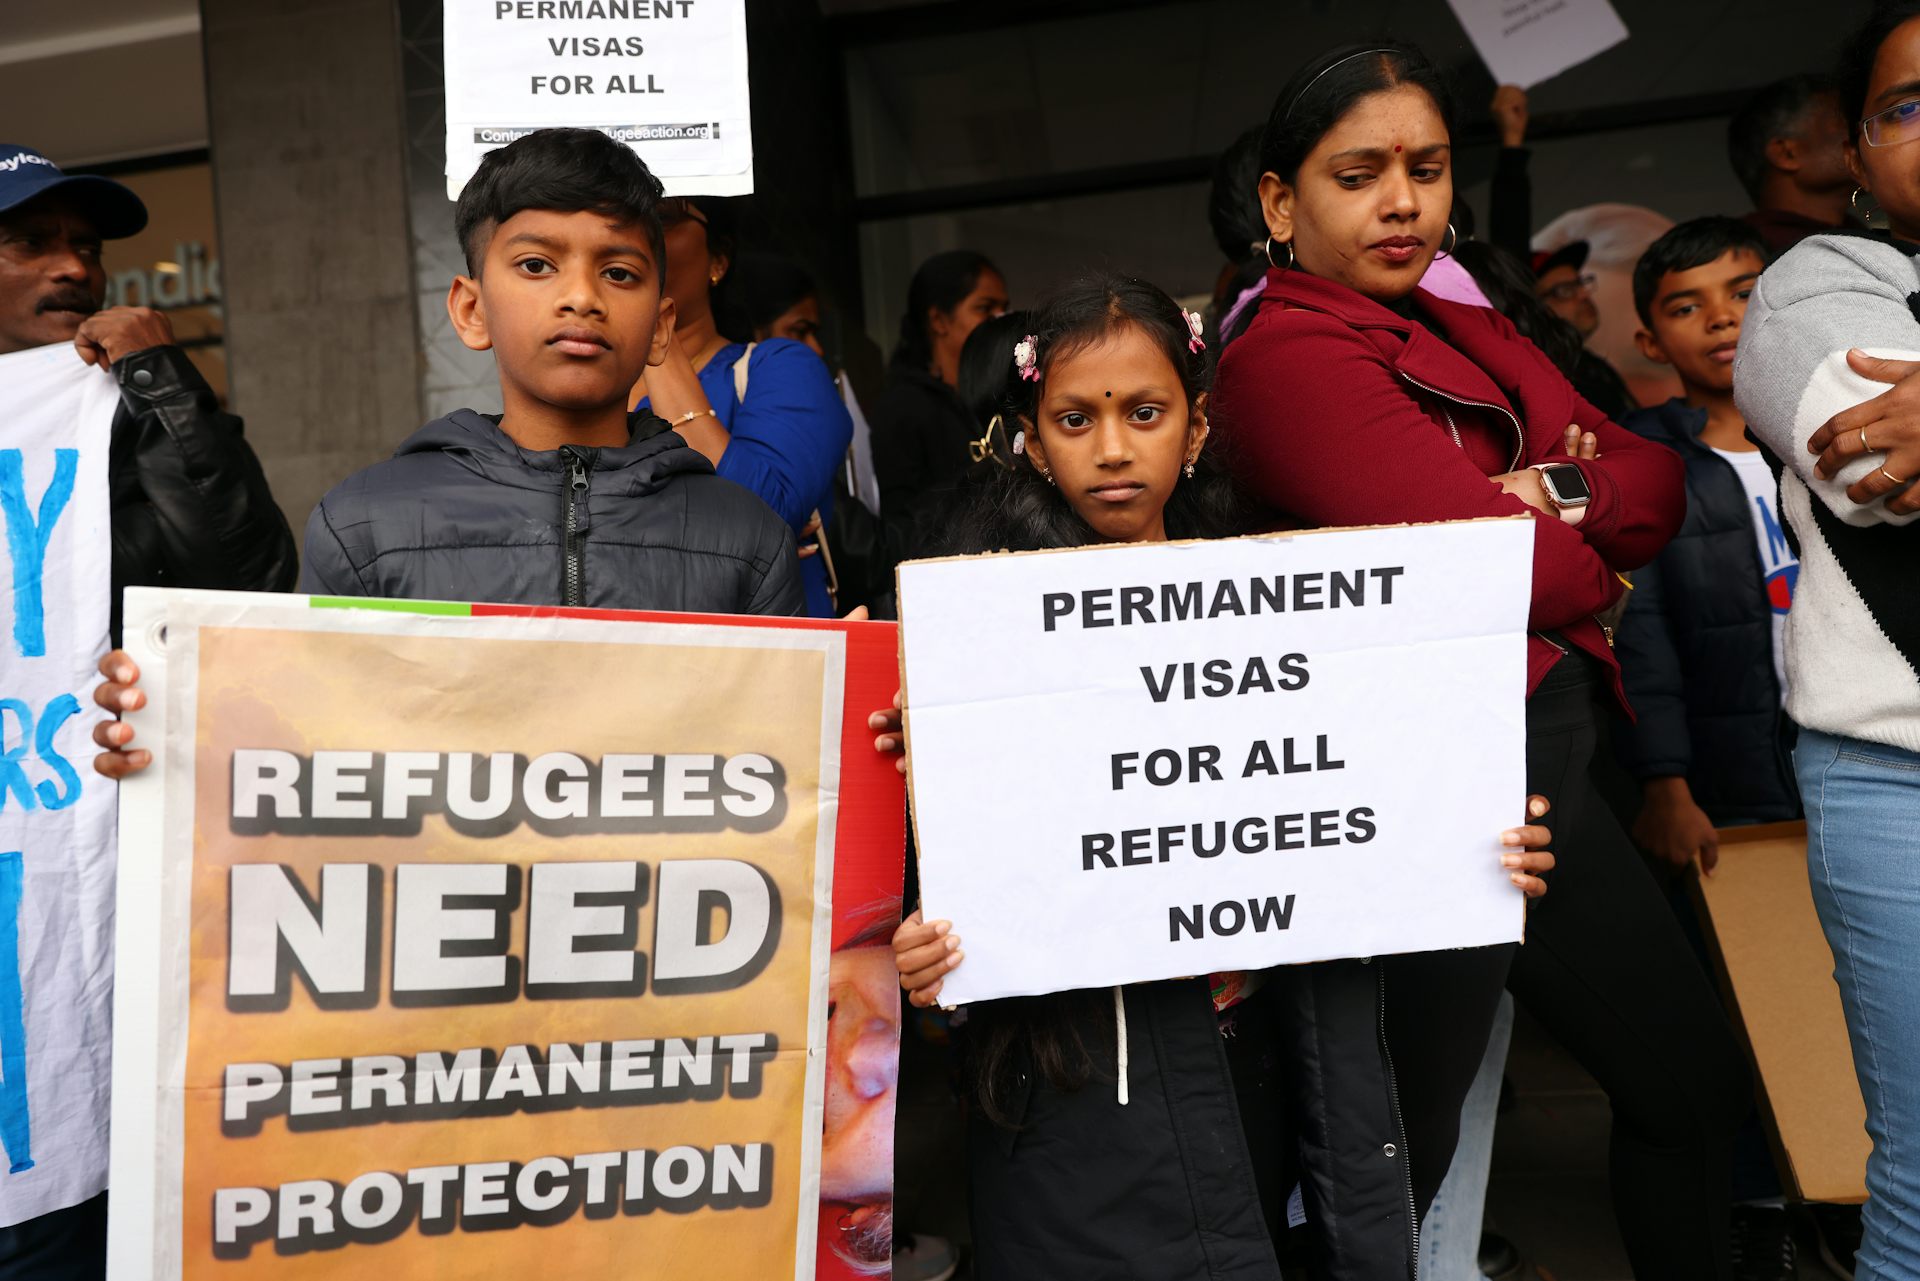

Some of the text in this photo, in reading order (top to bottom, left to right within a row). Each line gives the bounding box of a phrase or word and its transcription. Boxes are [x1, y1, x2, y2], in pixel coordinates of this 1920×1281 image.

[496, 0, 694, 20] PERMANENT
[548, 36, 644, 57] VISAS
[531, 74, 664, 95] FOR ALL
[1042, 566, 1404, 632] PERMANENT
[1139, 652, 1310, 703] VISAS
[230, 748, 780, 824] REFUGEES
[1111, 734, 1345, 791] FOR ALL
[1081, 806, 1377, 871] REFUGEES
[228, 858, 772, 999] NEED
[1168, 894, 1296, 942] NOW
[223, 1032, 769, 1124] PERMANENT
[214, 1142, 764, 1245] PROTECTION
